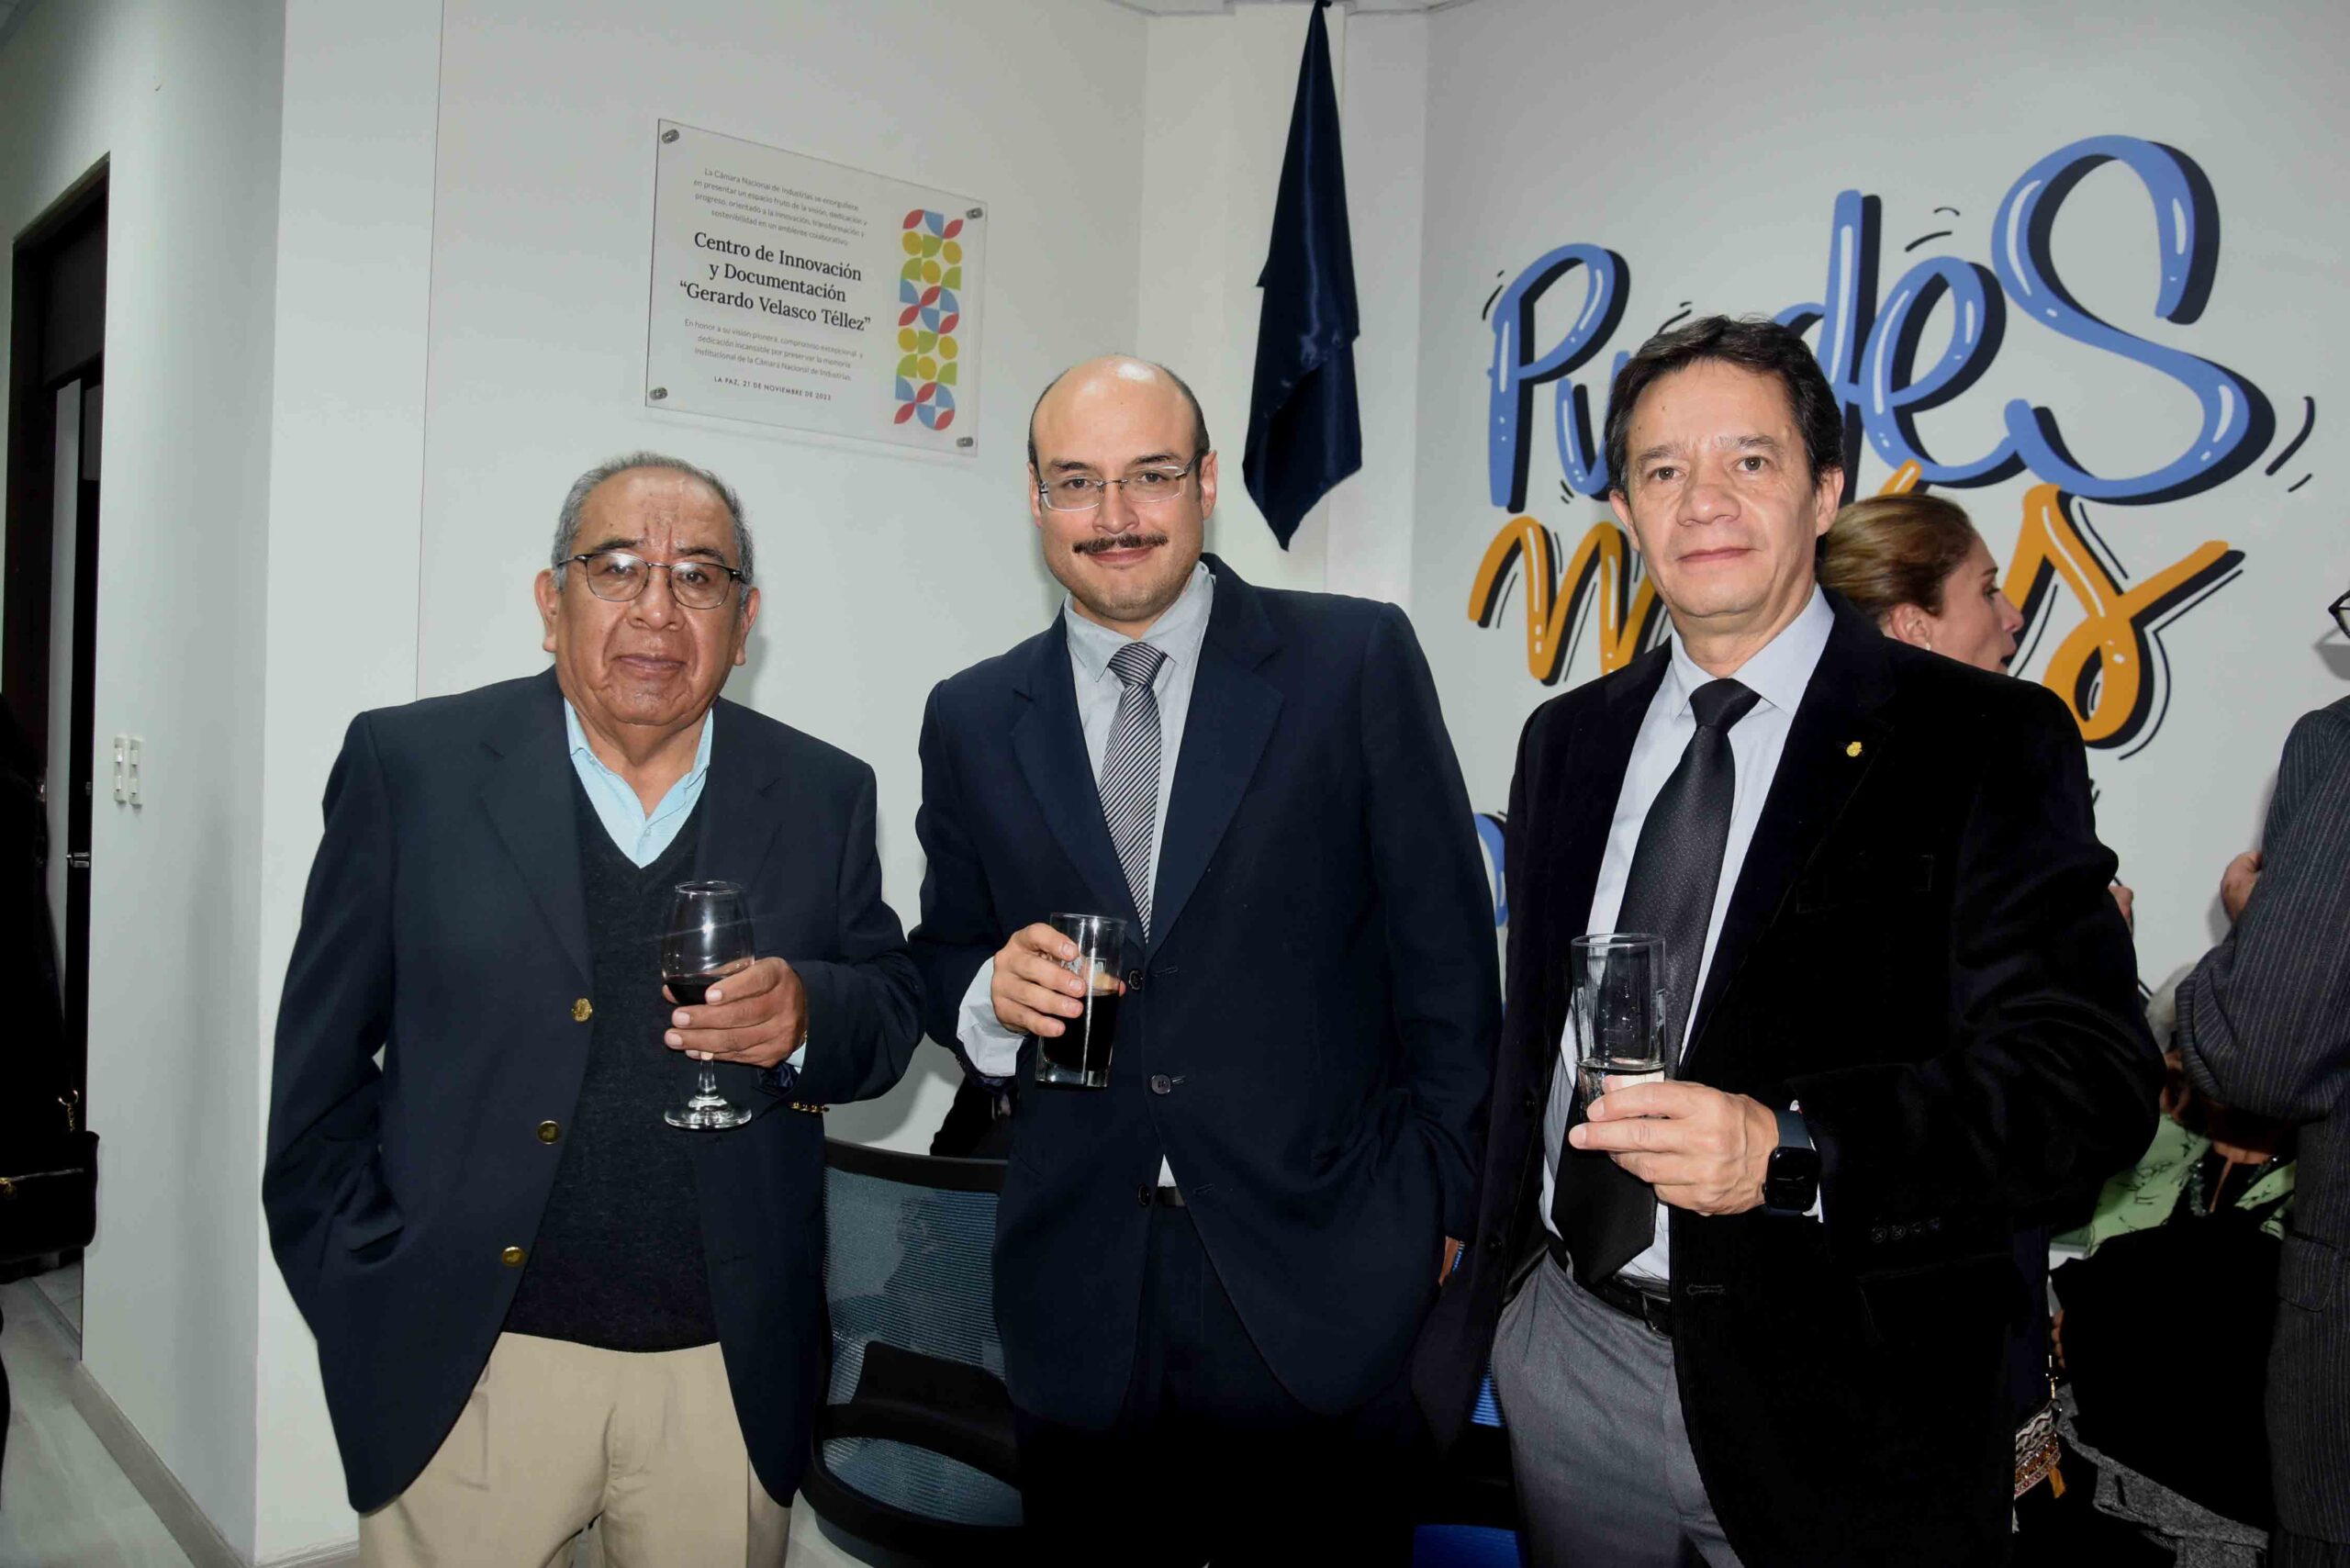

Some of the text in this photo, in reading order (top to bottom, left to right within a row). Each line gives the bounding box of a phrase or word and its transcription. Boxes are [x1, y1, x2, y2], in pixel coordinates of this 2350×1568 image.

[695, 232, 861, 281] Centro de Innovación
[710, 263, 845, 302] y Documentación
[680, 281, 870, 330] “Gerardo Velasco Téllez”
[765, 385, 801, 396] NOVIEMBRE
